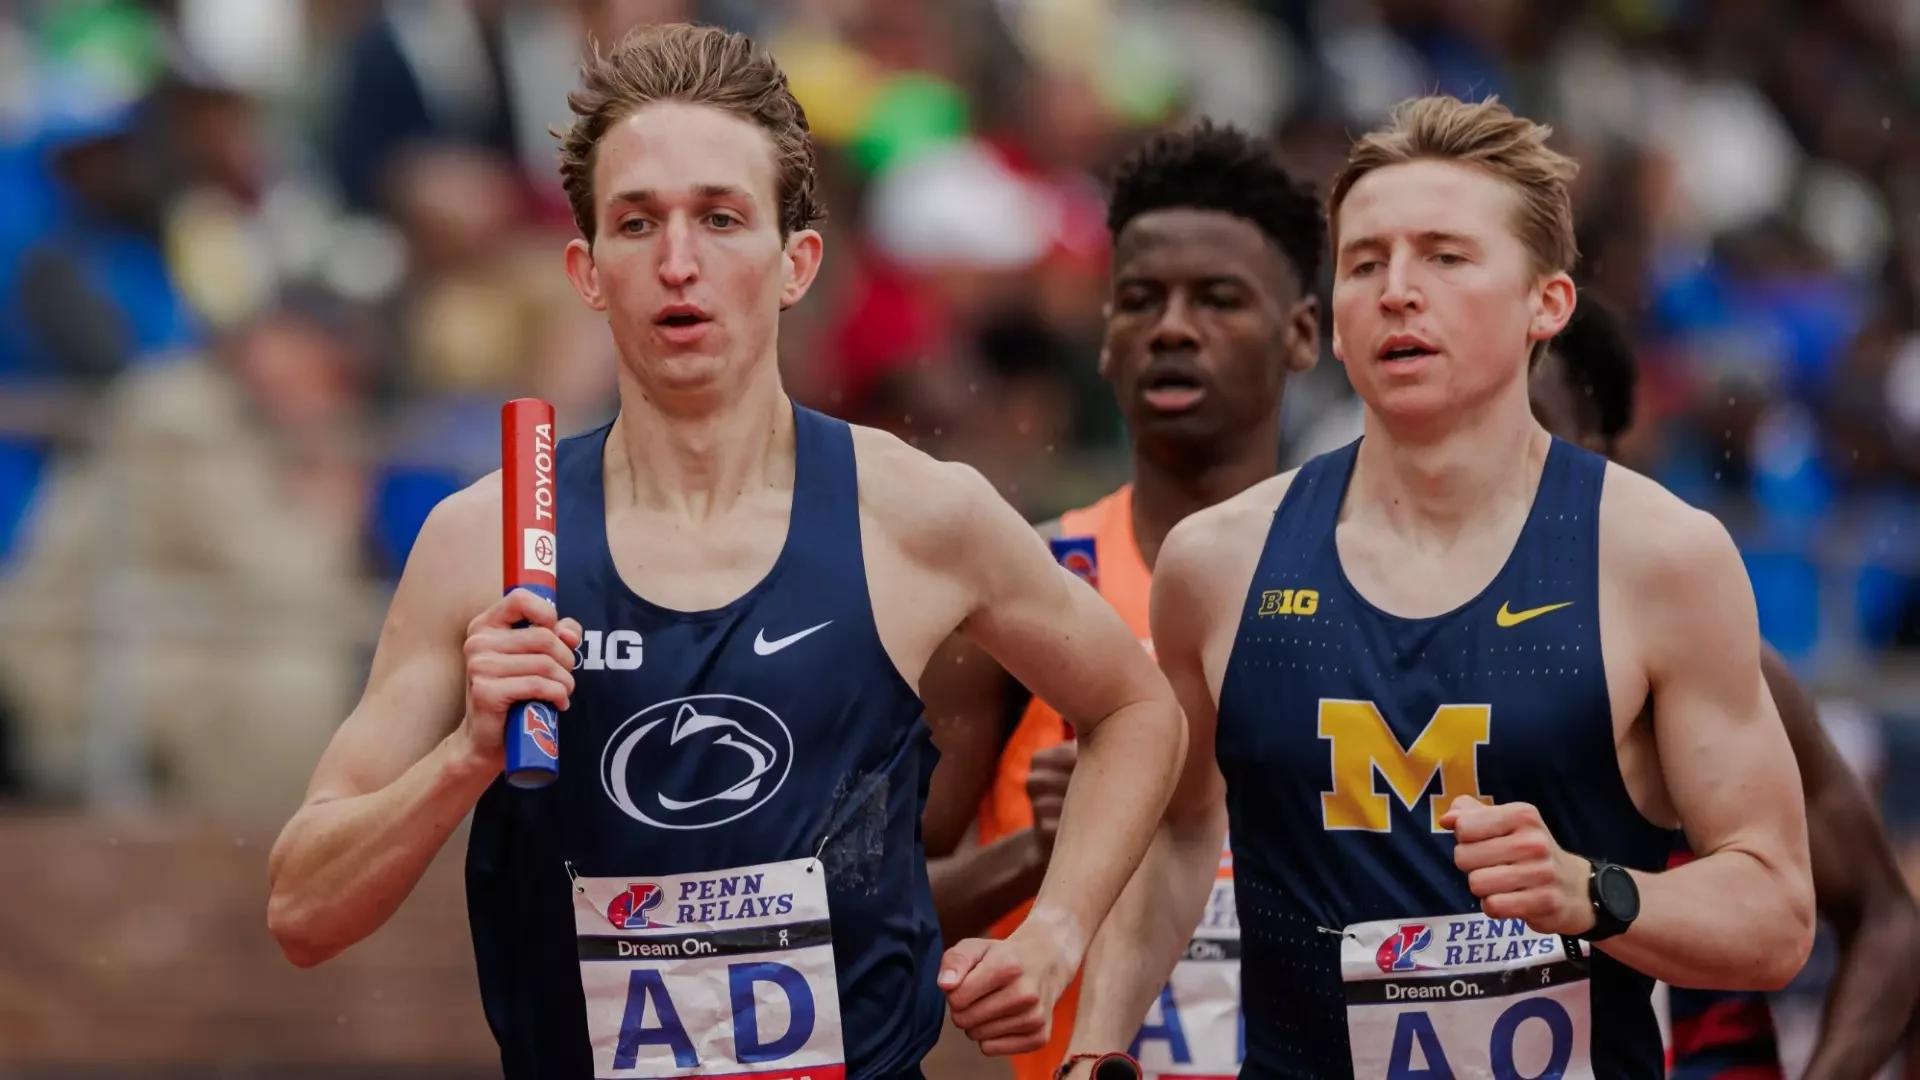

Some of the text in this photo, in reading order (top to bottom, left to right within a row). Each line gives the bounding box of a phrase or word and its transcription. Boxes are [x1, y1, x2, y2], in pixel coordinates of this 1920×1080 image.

[535, 423, 552, 520] TOYOTA
[1317, 698, 1494, 834] M
[677, 872, 765, 901] PENN
[676, 893, 794, 924] RELAYS
[1446, 917, 1527, 943] PENN
[617, 937, 718, 957] Dream On.
[1444, 937, 1555, 967] RELAYS
[1385, 979, 1485, 1000] Dream On.
